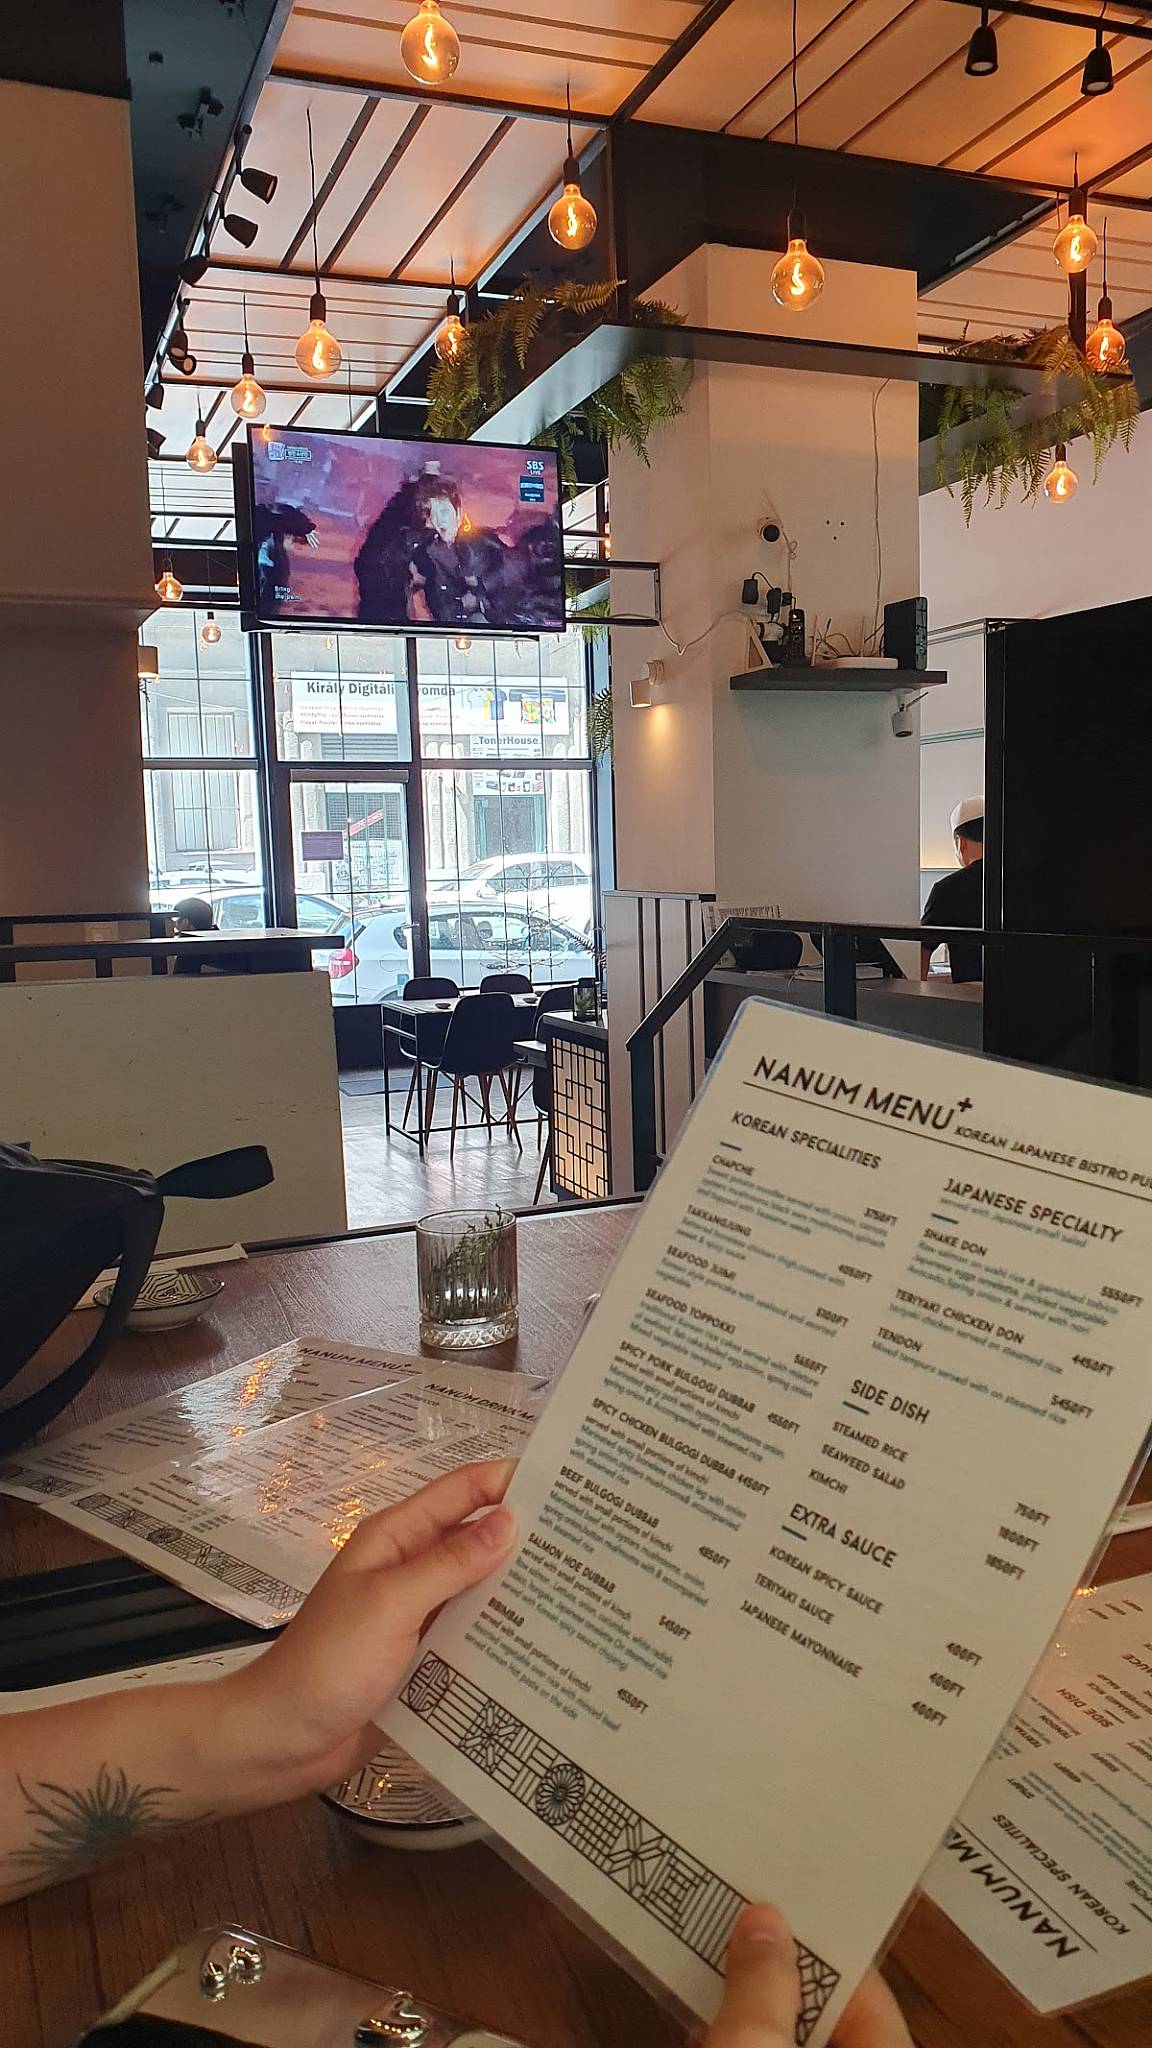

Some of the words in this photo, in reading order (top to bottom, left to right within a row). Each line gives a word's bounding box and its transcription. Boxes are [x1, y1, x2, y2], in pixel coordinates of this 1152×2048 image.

[526, 460, 544, 470] SBS
[307, 681, 345, 699] Király
[348, 682, 395, 697] Digitáli
[419, 687, 456, 697] omda
[753, 1056, 862, 1103] NANUM
[731, 1111, 788, 1138] KOREAN
[789, 1130, 881, 1168] SPECIALITIES
[955, 1125, 1007, 1147] KOREAN
[1010, 1141, 1075, 1166] JAPANESE
[1078, 1160, 1128, 1182] BISTRO
[1130, 1172, 1152, 1189] PU
[944, 1178, 1026, 1214] JAPANESE
[1029, 1204, 1121, 1244] SPECIALTY
[667, 1246, 709, 1268] SEAFOOD
[960, 1241, 986, 1256] DON
[645, 1288, 687, 1312] SEAFOOD
[895, 1289, 940, 1312] TERIYAKI
[942, 1306, 993, 1332] CHICKEN
[996, 1327, 1023, 1344] DON
[300, 1347, 355, 1364] NANUM
[877, 1327, 922, 1351] TENDON
[619, 1342, 645, 1359] SPICY
[647, 1355, 672, 1372] PORK
[674, 1368, 717, 1393] BULGOGI
[424, 1383, 481, 1404] NANUM
[850, 1379, 888, 1405] SIDE
[890, 1396, 930, 1424] DISH
[592, 1398, 617, 1416] SPICY
[618, 1412, 657, 1438] CHICKEN
[659, 1433, 699, 1459] BULGOGI
[832, 1421, 878, 1449] STEAMED
[881, 1444, 907, 1462] RICE
[560, 1466, 582, 1484] BEEF
[583, 1480, 623, 1507] BULGOGI
[809, 1469, 847, 1494] KIMCHI
[821, 1443, 869, 1473] SEAWEED
[872, 1467, 905, 1490] SALAD
[528, 1533, 562, 1559] SALMON
[563, 1555, 582, 1571] HOE
[790, 1503, 838, 1537] EXTRA
[841, 1530, 896, 1567] SAUCE
[755, 1573, 797, 1603] TERIYAKI
[798, 1598, 833, 1624] SAUCE
[770, 1545, 810, 1574] KOREAN
[813, 1569, 844, 1592] SPICY
[846, 1588, 882, 1613] SAUCE
[741, 1600, 789, 1635] JAPANESE
[790, 1629, 861, 1677] MAYONNAISE
[1056, 1688, 1087, 1709] DISH
[1083, 1708, 1114, 1729] SIDE
[992, 1814, 1072, 1883] SPECIALITIES
[970, 1864, 1081, 1959] NANUM
[1068, 1883, 1131, 1936] KOREAN
